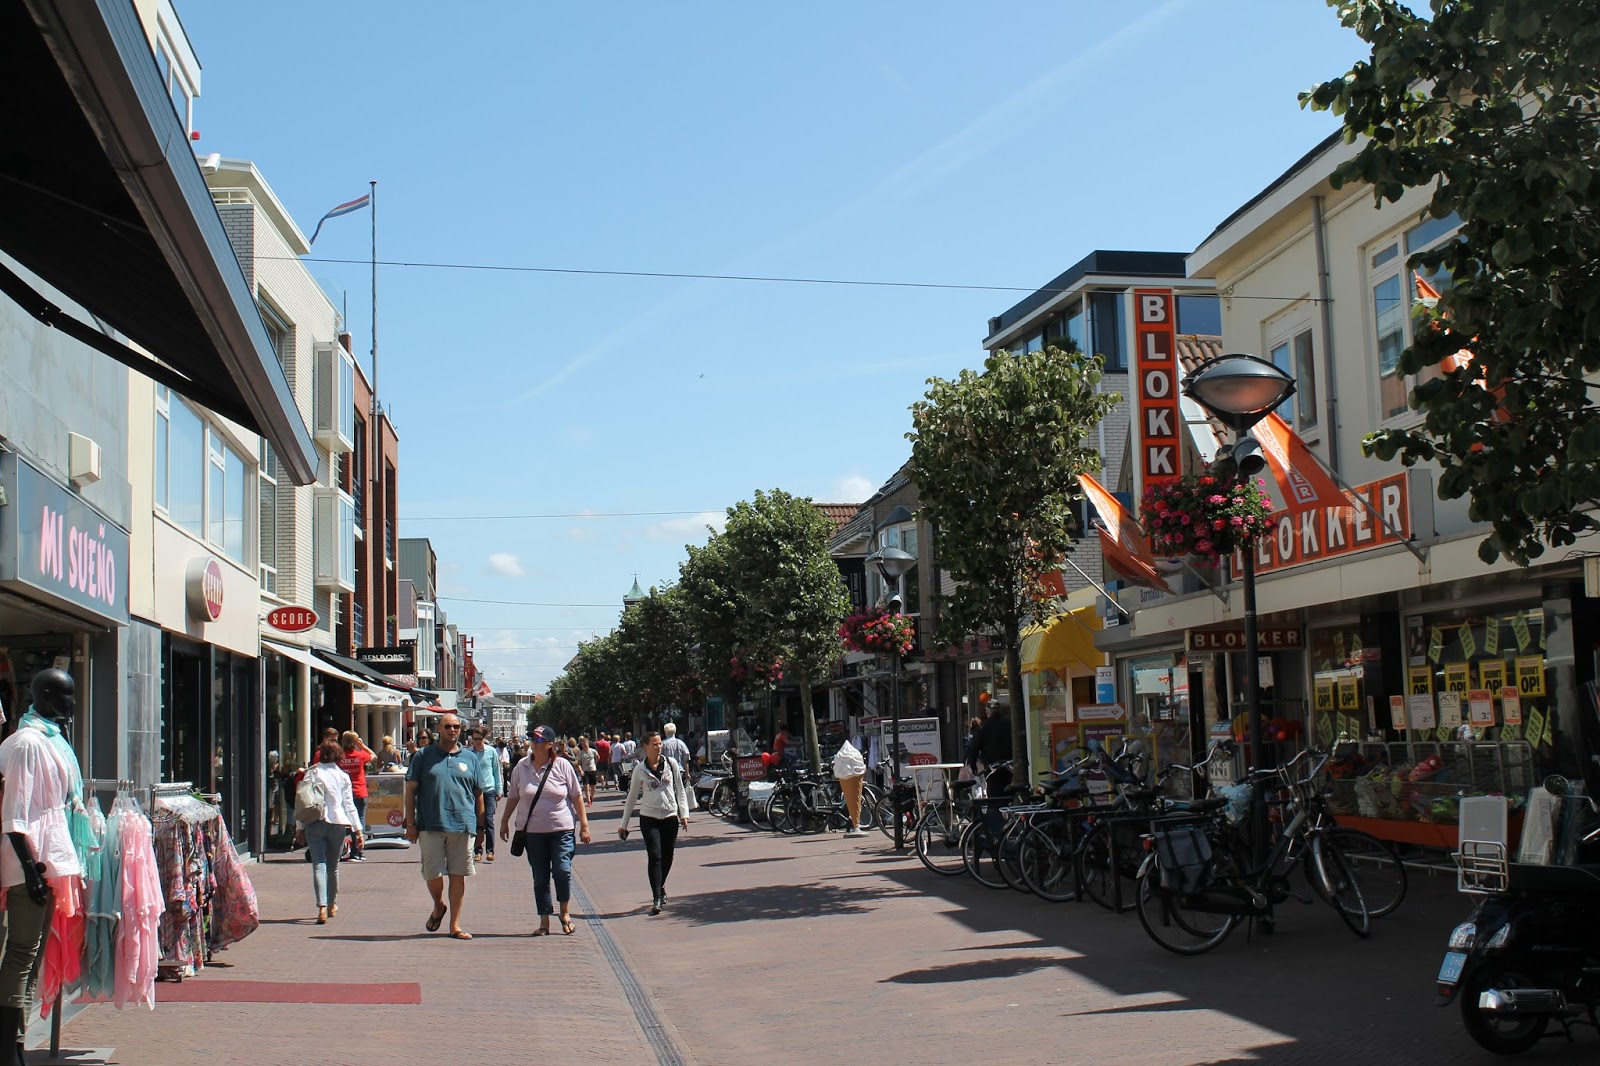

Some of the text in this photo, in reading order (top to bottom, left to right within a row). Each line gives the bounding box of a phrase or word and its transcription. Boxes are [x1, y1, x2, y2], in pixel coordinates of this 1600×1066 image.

[1141, 294, 1174, 476] BLOKK
[40, 505, 115, 606] MI SUEÑO
[272, 612, 312, 625] SCORE
[1521, 676, 1541, 694] OP!
[1318, 692, 1331, 707] OP!
[1341, 691, 1356, 706] OP!
